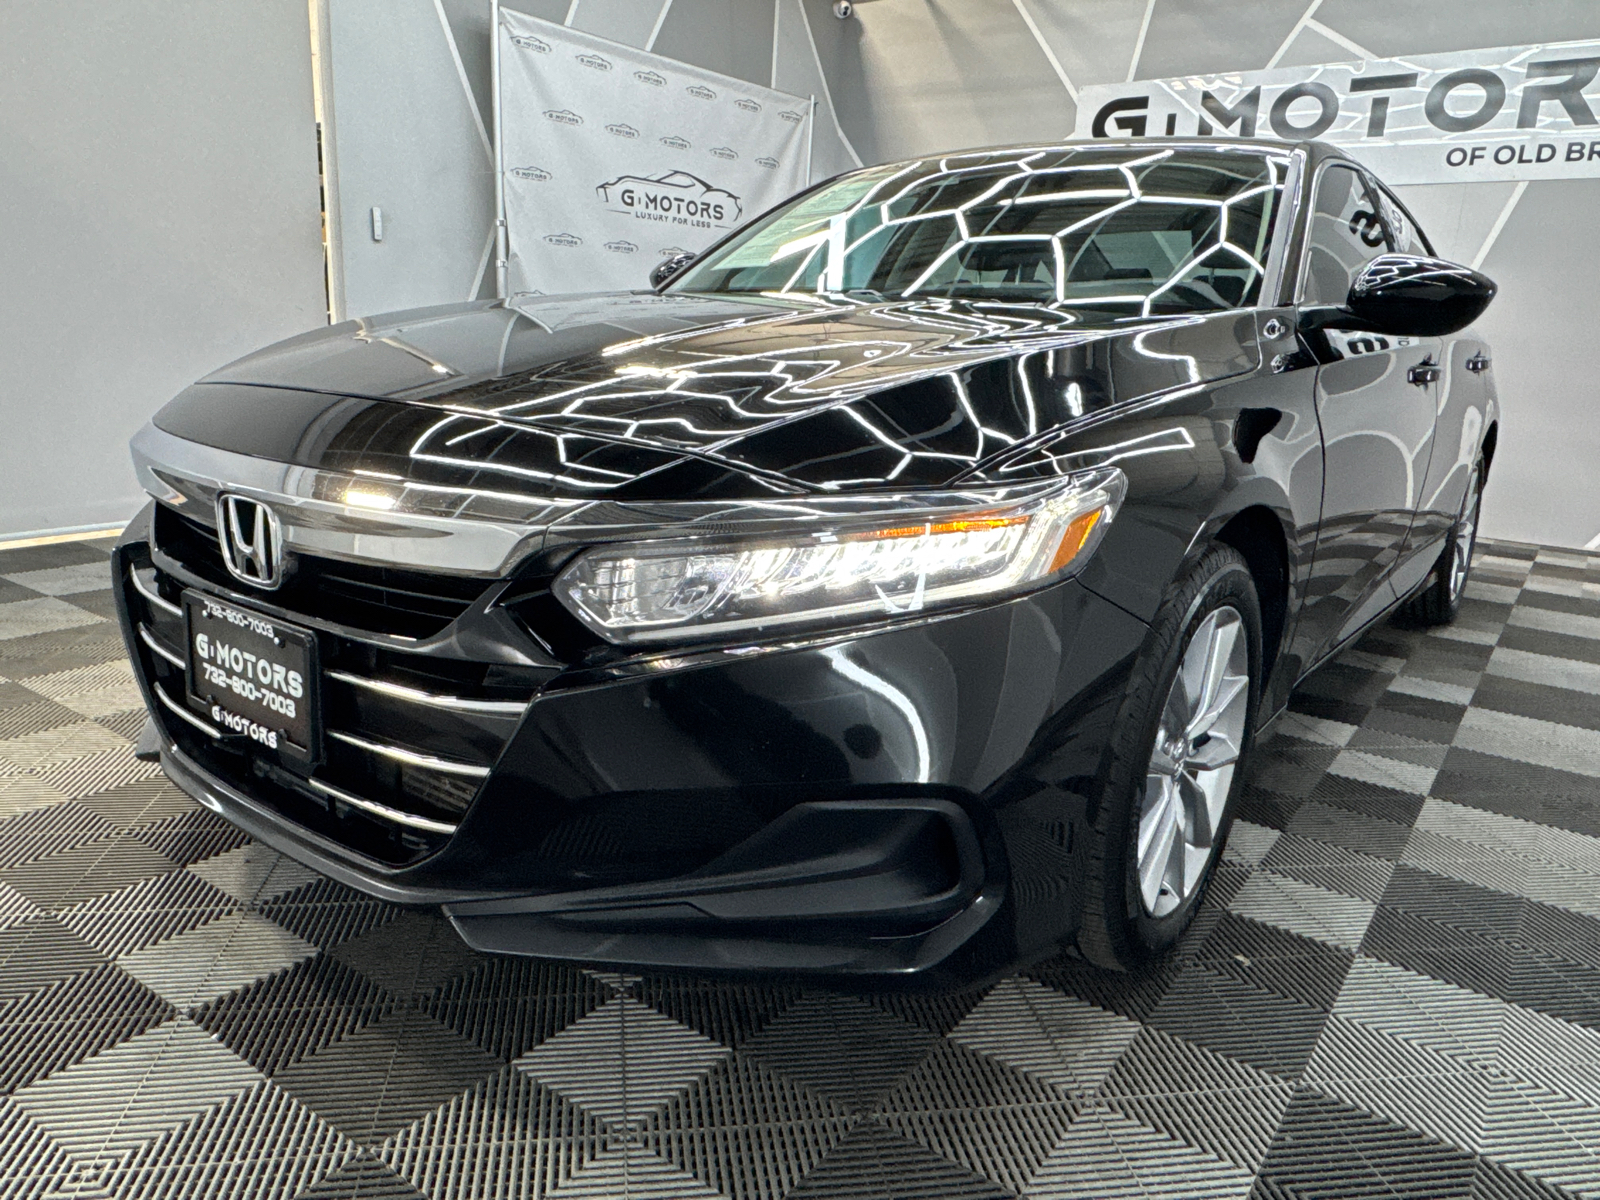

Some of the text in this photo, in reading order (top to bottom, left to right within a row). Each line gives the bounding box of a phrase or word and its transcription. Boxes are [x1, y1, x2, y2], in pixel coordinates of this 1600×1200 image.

[1446, 146, 1487, 167] OF
[1493, 143, 1557, 165] OLD
[635, 211, 711, 229] LUXURY FOR LESS
[645, 191, 724, 221] MOTORS
[203, 600, 275, 639] 732-800-7003
[216, 639, 304, 699] MOTORS
[202, 662, 296, 719] 732-800-7003
[223, 709, 278, 749] MOTORS
